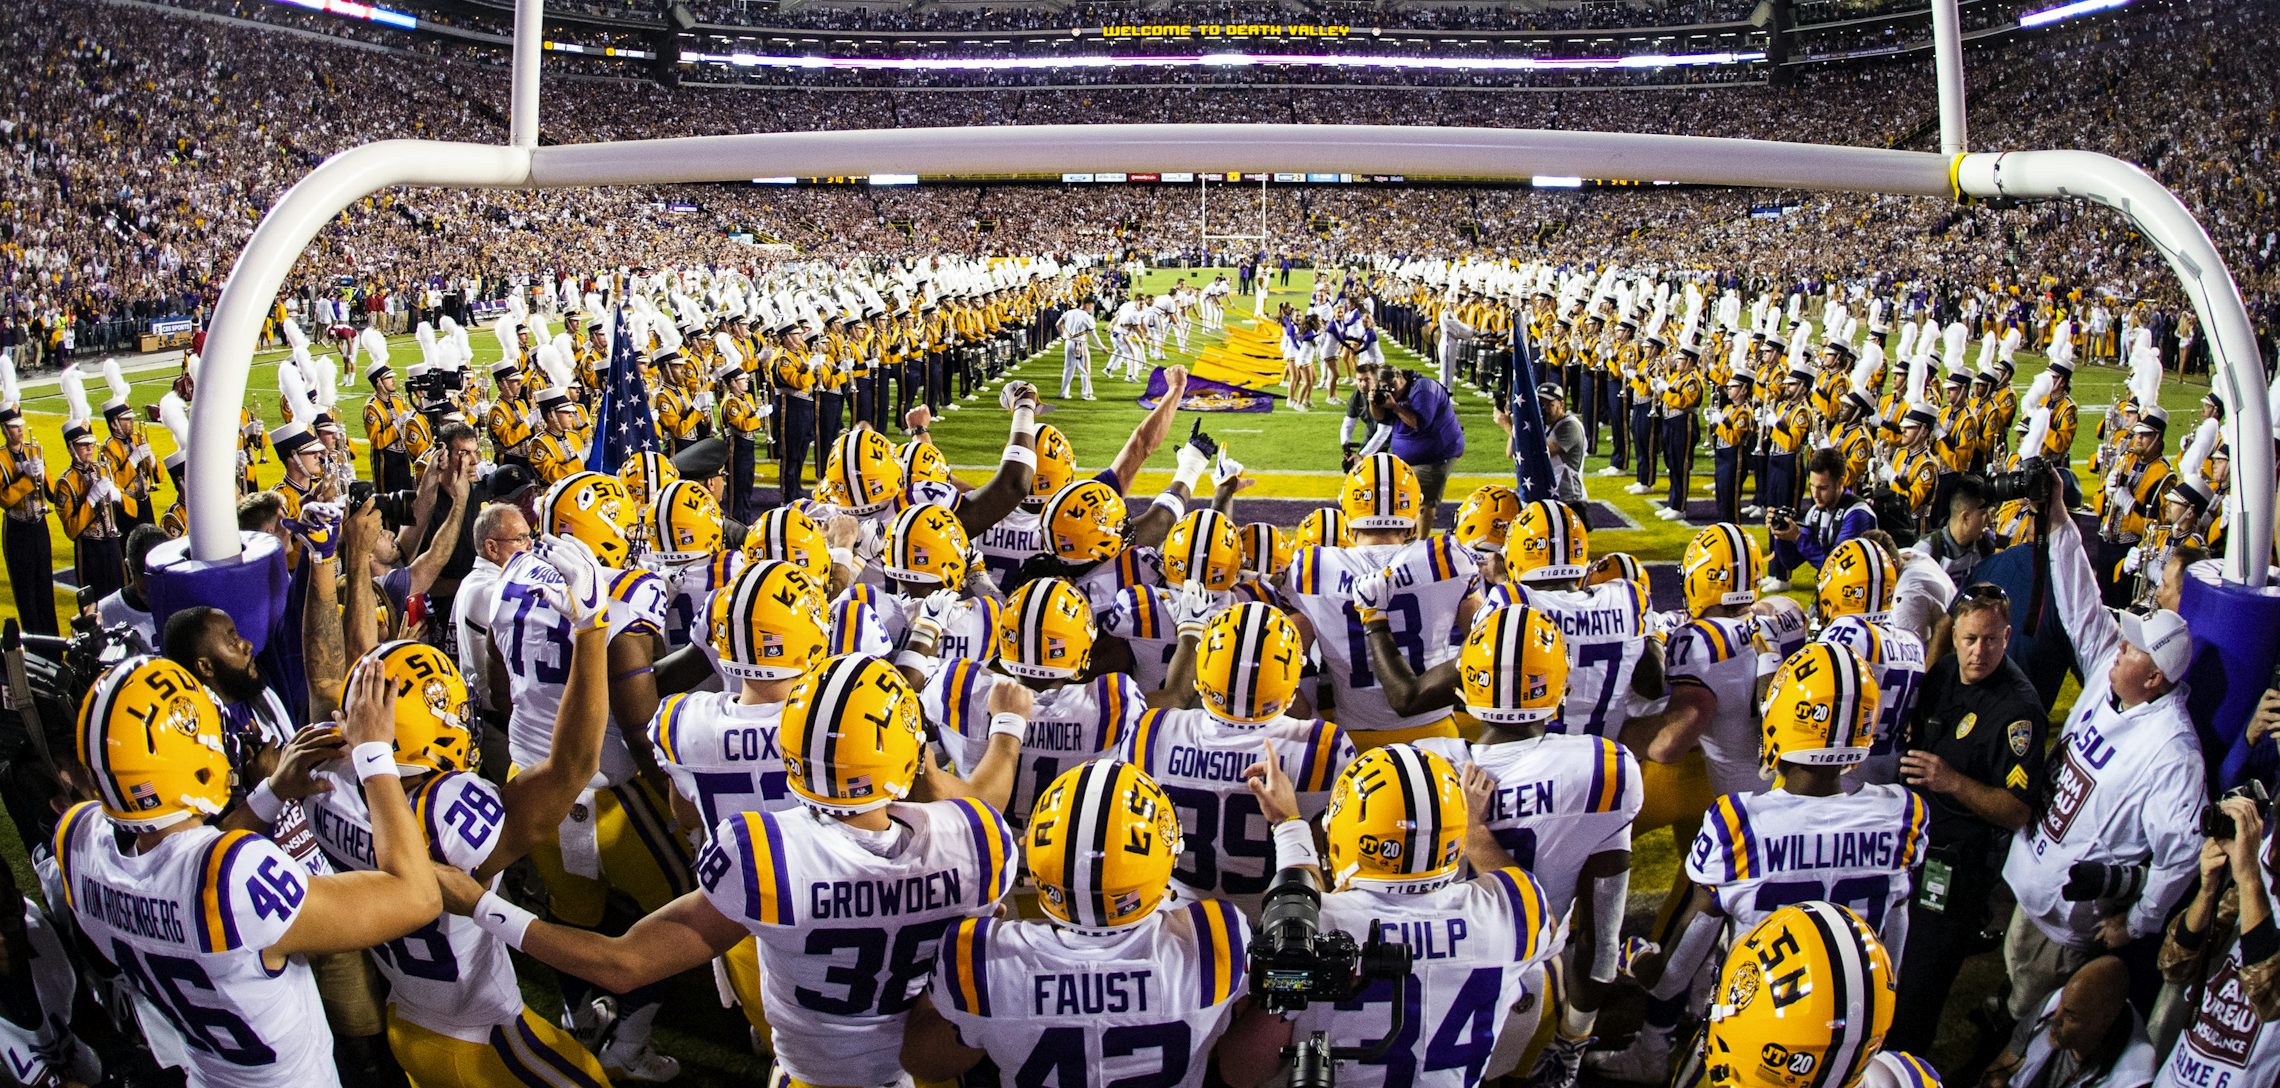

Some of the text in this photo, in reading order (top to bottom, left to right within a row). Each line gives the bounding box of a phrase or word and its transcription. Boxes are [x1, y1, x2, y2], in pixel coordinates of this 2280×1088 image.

[1103, 24, 1350, 36] WELCOME TO DEATH VALLEY
[172, 323, 190, 331] SPORTS
[1362, 489, 1373, 501] 20
[982, 529, 1044, 551] CHARL
[1536, 538, 1547, 551] 20
[1541, 568, 1580, 578] TIGERS
[1854, 586, 1865, 599] 20
[502, 581, 576, 684] 73
[722, 665, 775, 679] TIGERS
[1009, 665, 1056, 678] TIGERS
[1477, 671, 1491, 687] 20
[126, 669, 198, 727] LSU
[1481, 711, 1538, 721] TIGERS
[1795, 701, 1829, 722] JT 20
[724, 727, 781, 761] COX
[788, 757, 801, 777] 20
[1169, 744, 1285, 788] GONSOU
[1809, 753, 1861, 763] TIGERS
[1492, 779, 1554, 821] EEN
[443, 781, 507, 850] 28
[280, 828, 314, 854] INSUR
[1359, 836, 1402, 859] JT 20
[1765, 831, 1893, 873] WILLIAMS
[246, 856, 305, 922] 46
[811, 867, 962, 920] GROWDEN
[1047, 885, 1064, 907] 20
[1384, 882, 1449, 895] TIGERS
[82, 874, 186, 945] VON ROSENBERG
[111, 936, 277, 1067] 46
[1034, 970, 1152, 1015] FAUST
[2201, 985, 2257, 1034] UREAU
[2192, 1020, 2248, 1055] NSURANCE
[1762, 1044, 1788, 1066] JT
[1789, 1053, 1815, 1076] 20
